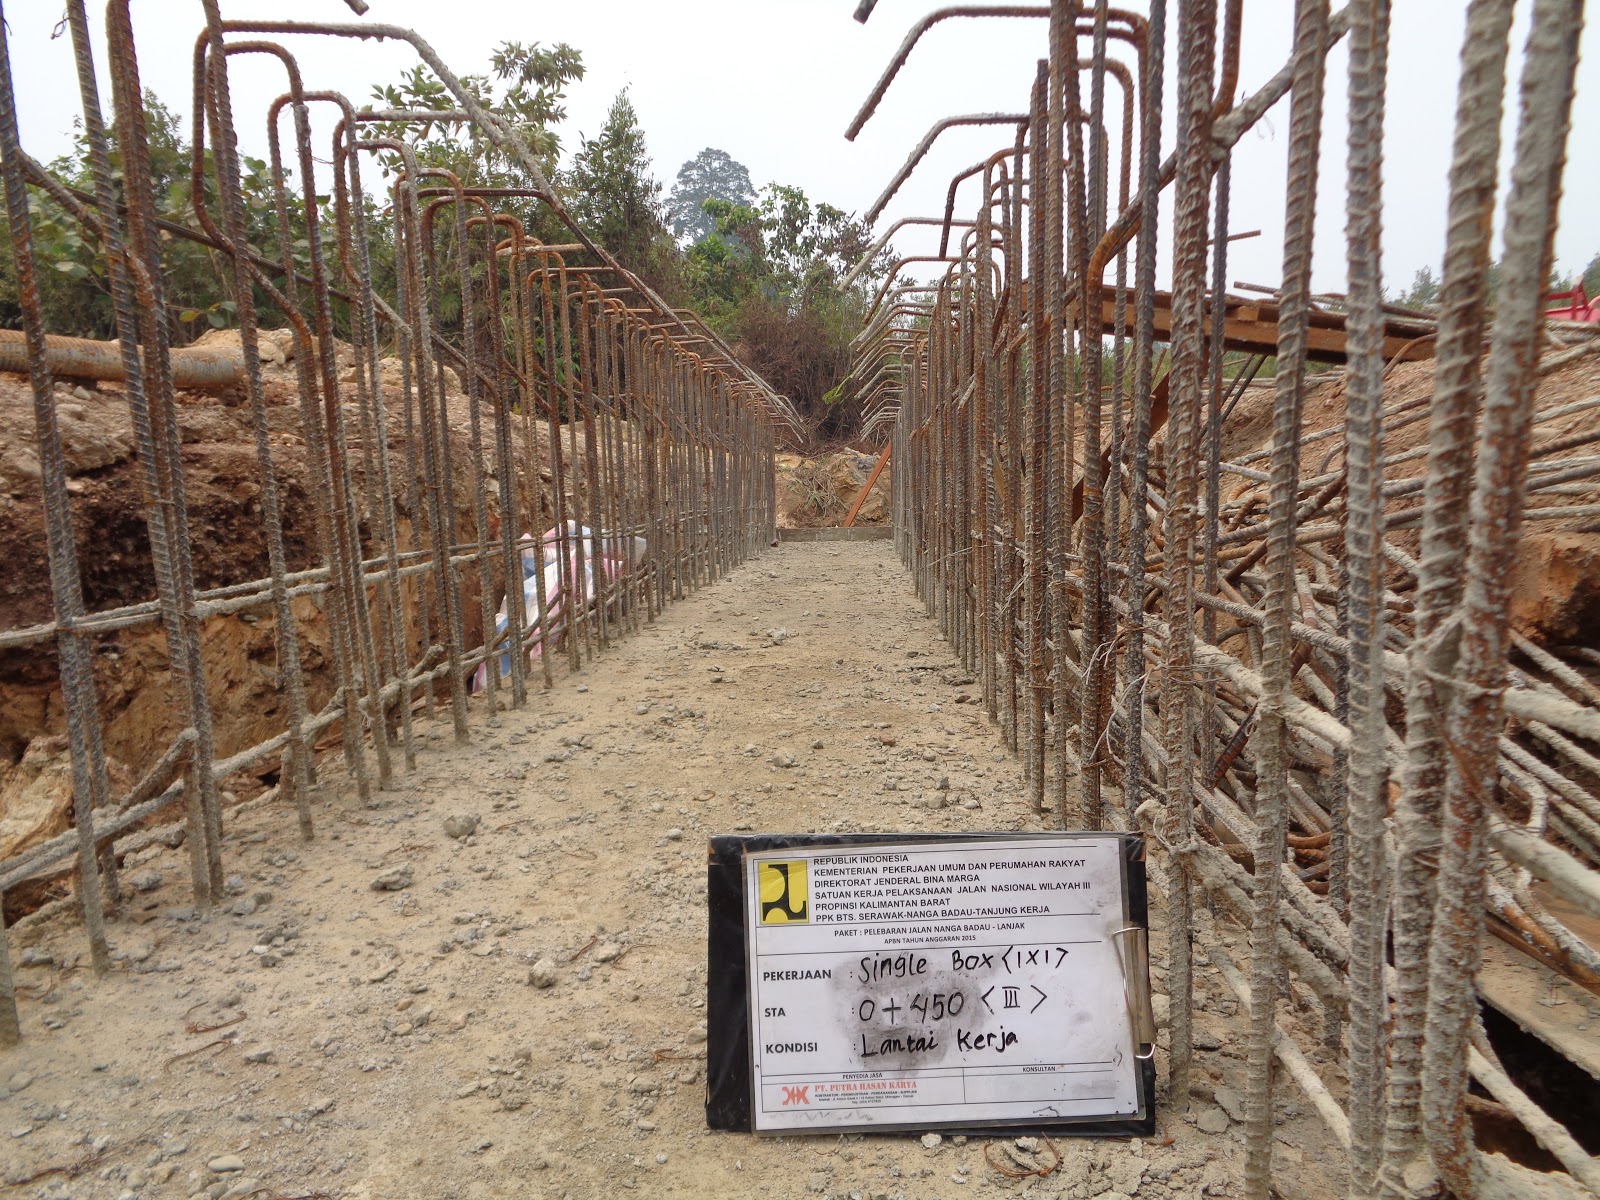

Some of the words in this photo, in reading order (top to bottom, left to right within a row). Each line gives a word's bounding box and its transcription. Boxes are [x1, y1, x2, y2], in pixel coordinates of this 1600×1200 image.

[813, 856, 858, 865] REPUBLIK
[860, 854, 909, 864] INDONESIA
[814, 866, 878, 876] KEMENTERIAN
[882, 864, 936, 874] PEKERJAAN
[938, 863, 966, 872] UMUM
[968, 862, 987, 871] DAN
[989, 860, 1046, 870] PERUMAHAN
[1048, 859, 1086, 868] RAKYAT
[814, 878, 871, 888] DIREKTORAT
[874, 876, 921, 886] JENDERAL
[923, 875, 945, 884] BINA
[946, 874, 980, 883] MARGA
[815, 891, 851, 900] SATUAN
[853, 889, 884, 898] KERJA
[885, 886, 953, 897] PELAKSANAAN
[957, 885, 987, 894] JALAN
[991, 883, 1037, 893] NASIONAL
[1039, 882, 1081, 891] WILAYAH
[1082, 881, 1091, 890] III
[815, 901, 858, 911] PROPINSI
[859, 900, 918, 910] KALIMANTAN
[920, 898, 951, 907] BARAT
[816, 913, 834, 922] PPK
[836, 912, 857, 921] BTS.
[858, 909, 939, 920] SERAWAK-NANGA
[941, 906, 1018, 917] BADAU-TANJUNG
[1020, 905, 1050, 914] KERJA
[834, 929, 858, 937] PAKET
[864, 927, 907, 936] PELEBARAN
[909, 926, 932, 934] JALAN
[934, 925, 962, 933] NANGA
[963, 924, 991, 932] BADAU
[997, 922, 1025, 930] LANJAK
[925, 935, 961, 943] ANGGARAN
[763, 969, 832, 981] PEKERJAAN
[764, 1007, 786, 1017] STA
[765, 1042, 818, 1054] KONDISI
[861, 1031, 938, 1058] Lantai
[814, 1084, 828, 1093] PT.
[830, 1083, 858, 1092] PUTRA
[859, 1082, 887, 1091] HASAN
[889, 1081, 917, 1090] KARYA
